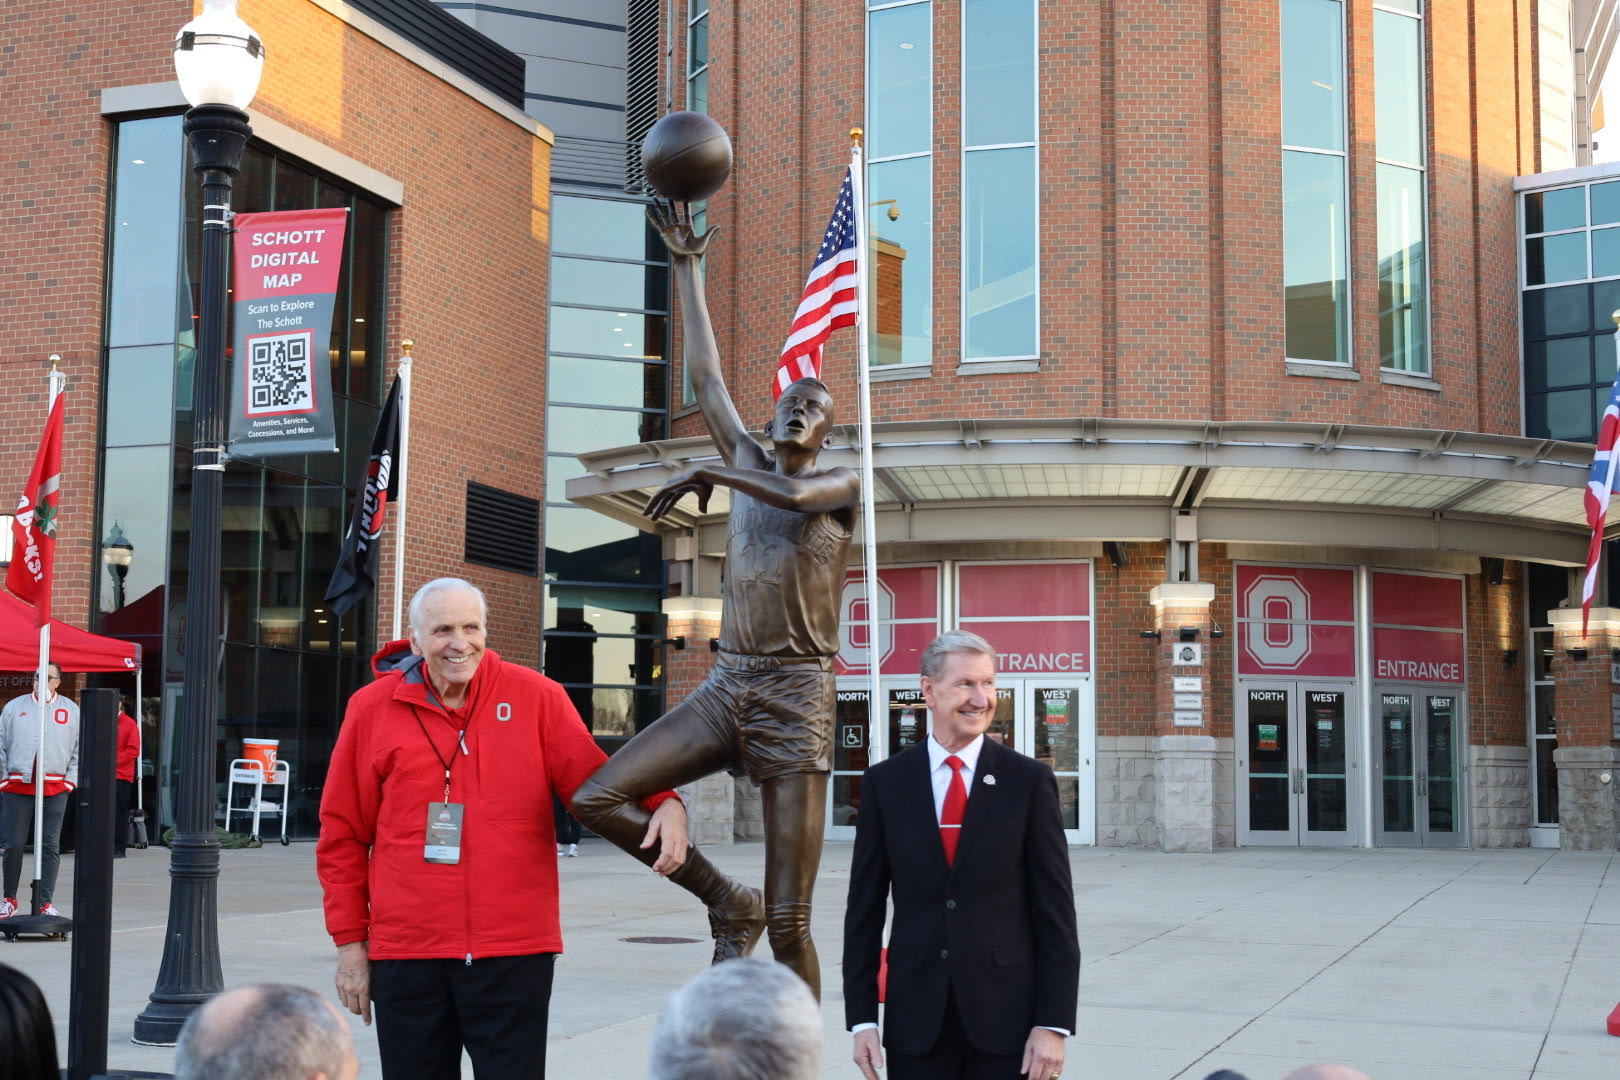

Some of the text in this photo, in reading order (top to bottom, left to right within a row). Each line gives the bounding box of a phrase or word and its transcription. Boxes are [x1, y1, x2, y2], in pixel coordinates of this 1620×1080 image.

[252, 229, 325, 246] SCHOTT
[251, 251, 320, 268] DIGITAL
[263, 273, 303, 289] MAP
[248, 300, 315, 315] Scan to Explore
[258, 316, 303, 329] The Schott
[252, 416, 309, 428] Amenities, Services,
[248, 426, 315, 438] Concessions, and More!
[996, 652, 1084, 671] TRANCE
[1378, 659, 1459, 680] ENTRANCE
[837, 692, 869, 702] NORTH
[896, 691, 921, 700] WEST
[1042, 690, 1071, 699] WEST
[1250, 692, 1284, 702] NORTH
[1312, 693, 1337, 703] WEST
[1383, 696, 1409, 705] NORTH
[1430, 698, 1451, 707] WEST
